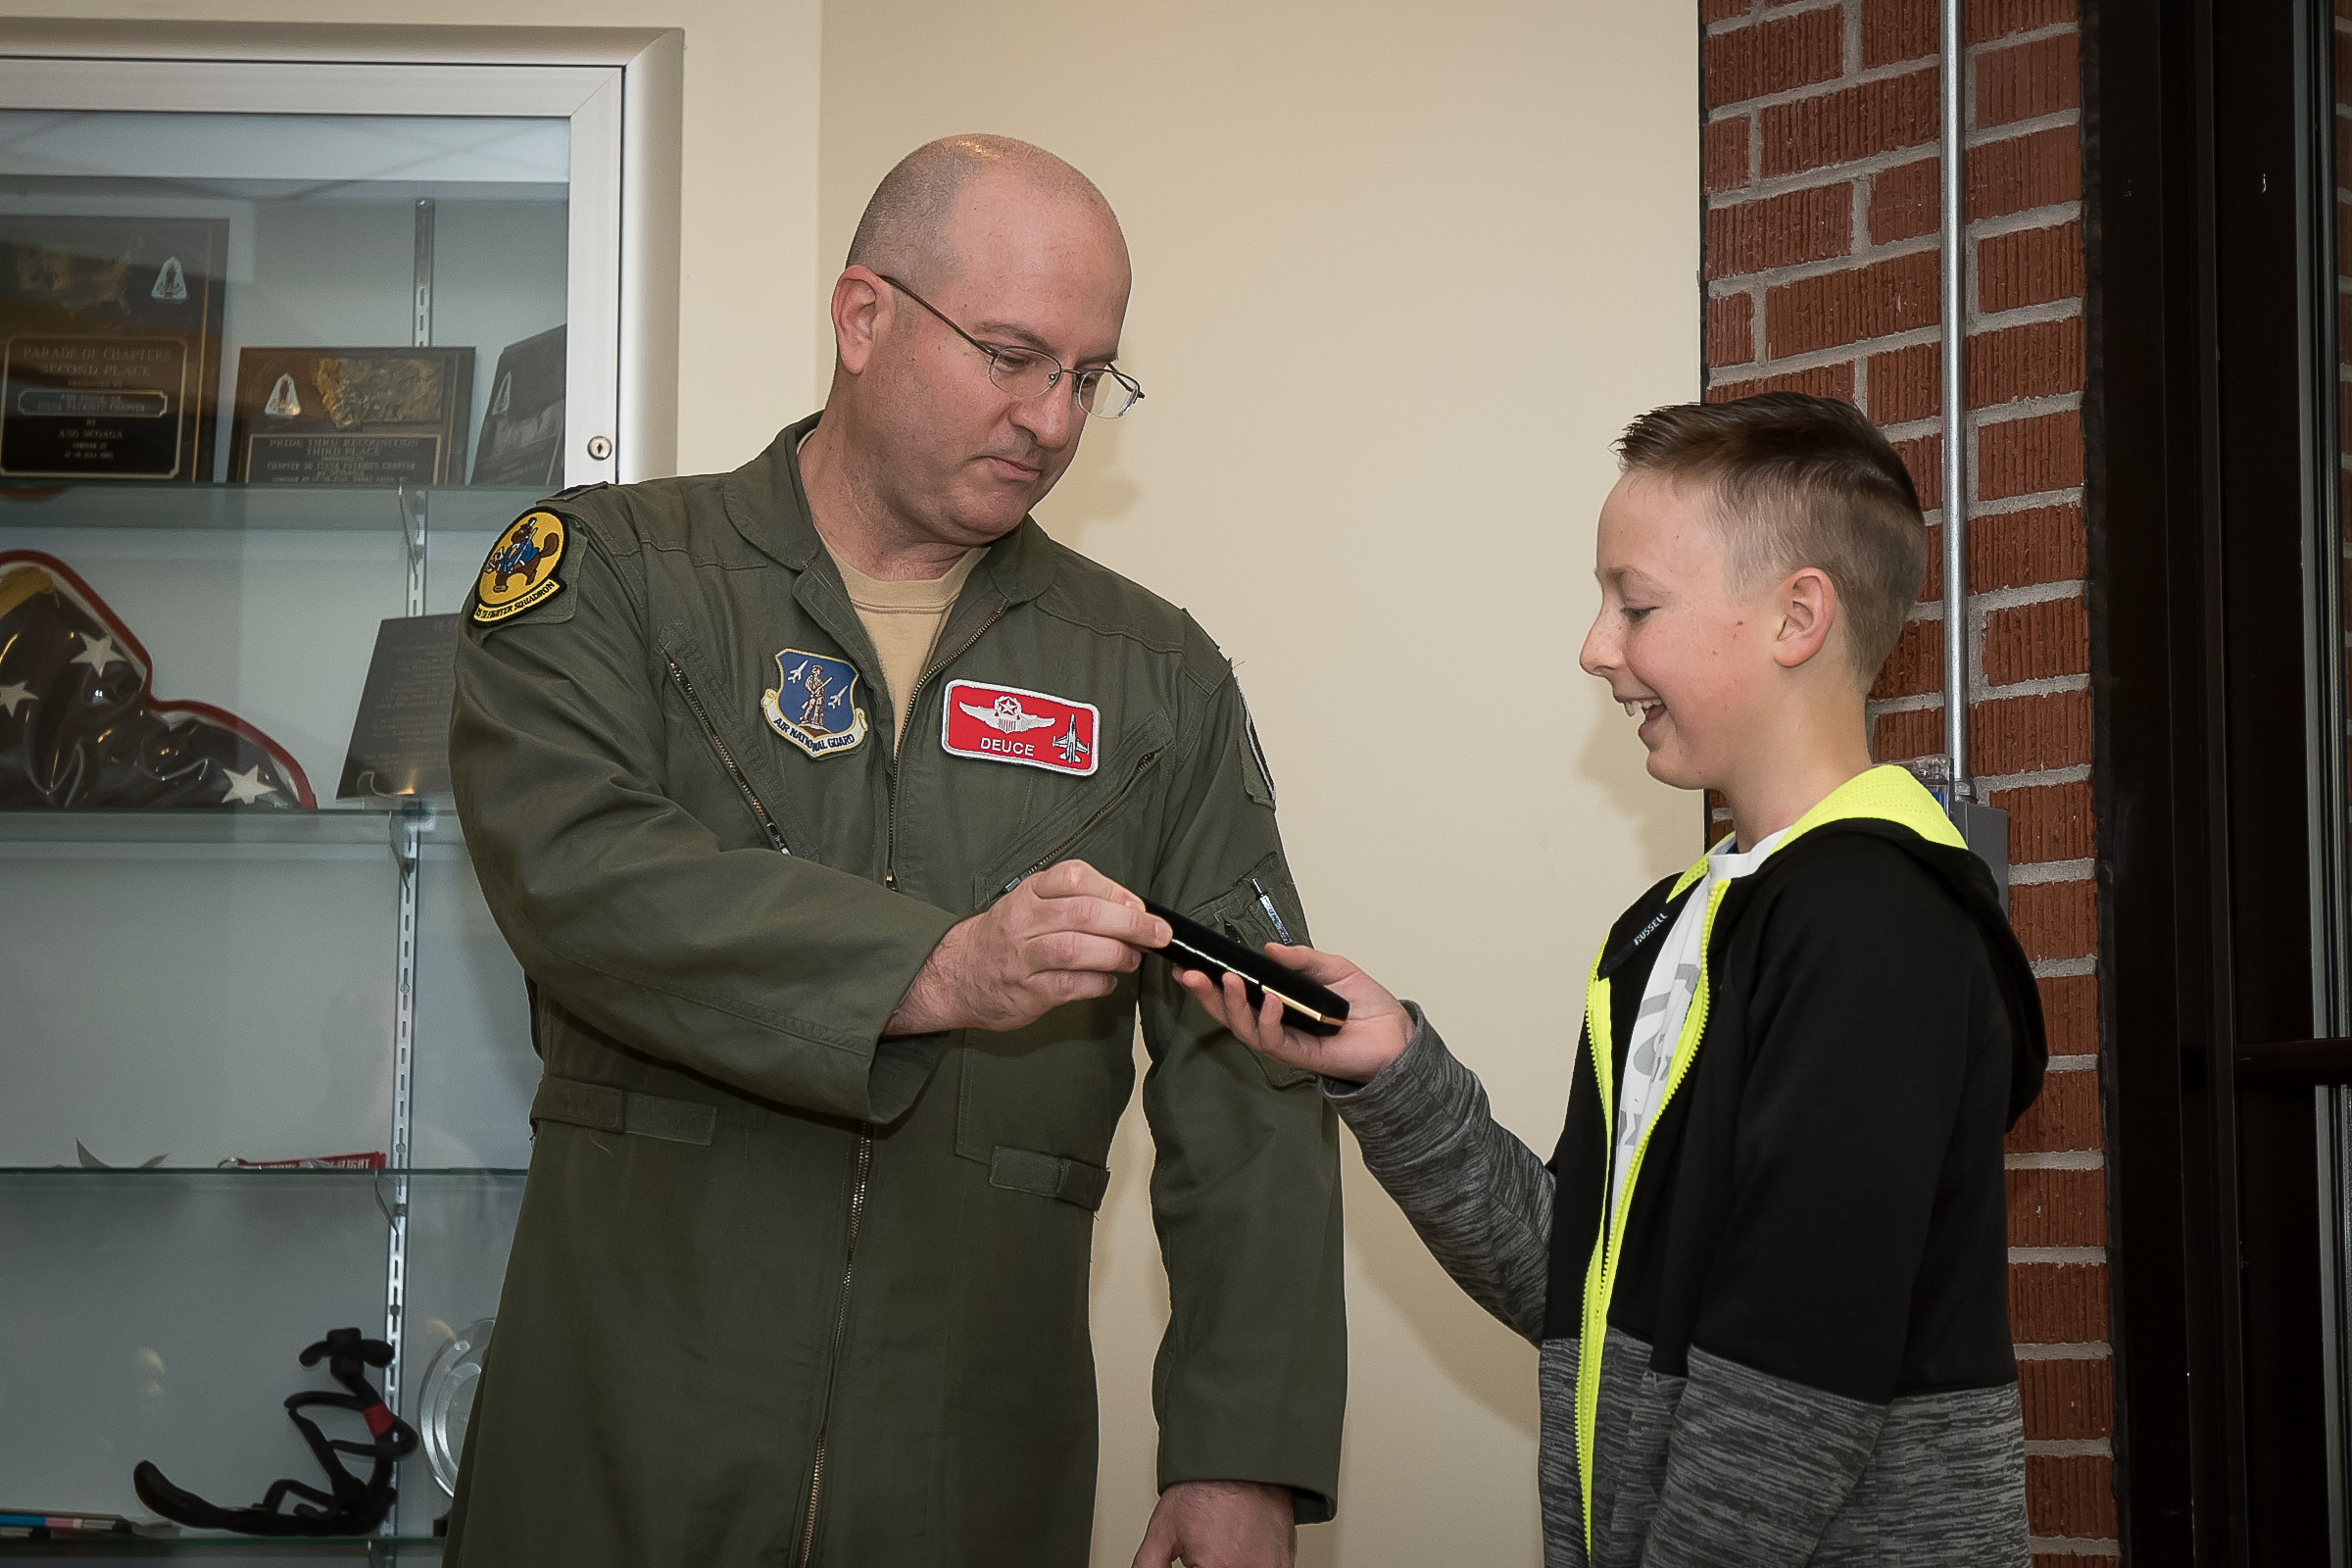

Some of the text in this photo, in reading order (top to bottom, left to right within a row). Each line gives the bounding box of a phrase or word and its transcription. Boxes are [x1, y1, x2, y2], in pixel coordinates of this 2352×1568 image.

[24, 347, 74, 361] PARADE
[103, 348, 172, 361] CHAPTERS
[514, 581, 555, 610] SQUADRON
[772, 717, 856, 753] AIR NATIONAL GUARD
[980, 737, 1035, 757] DEUCE
[1634, 912, 1668, 946] RUSSELL
